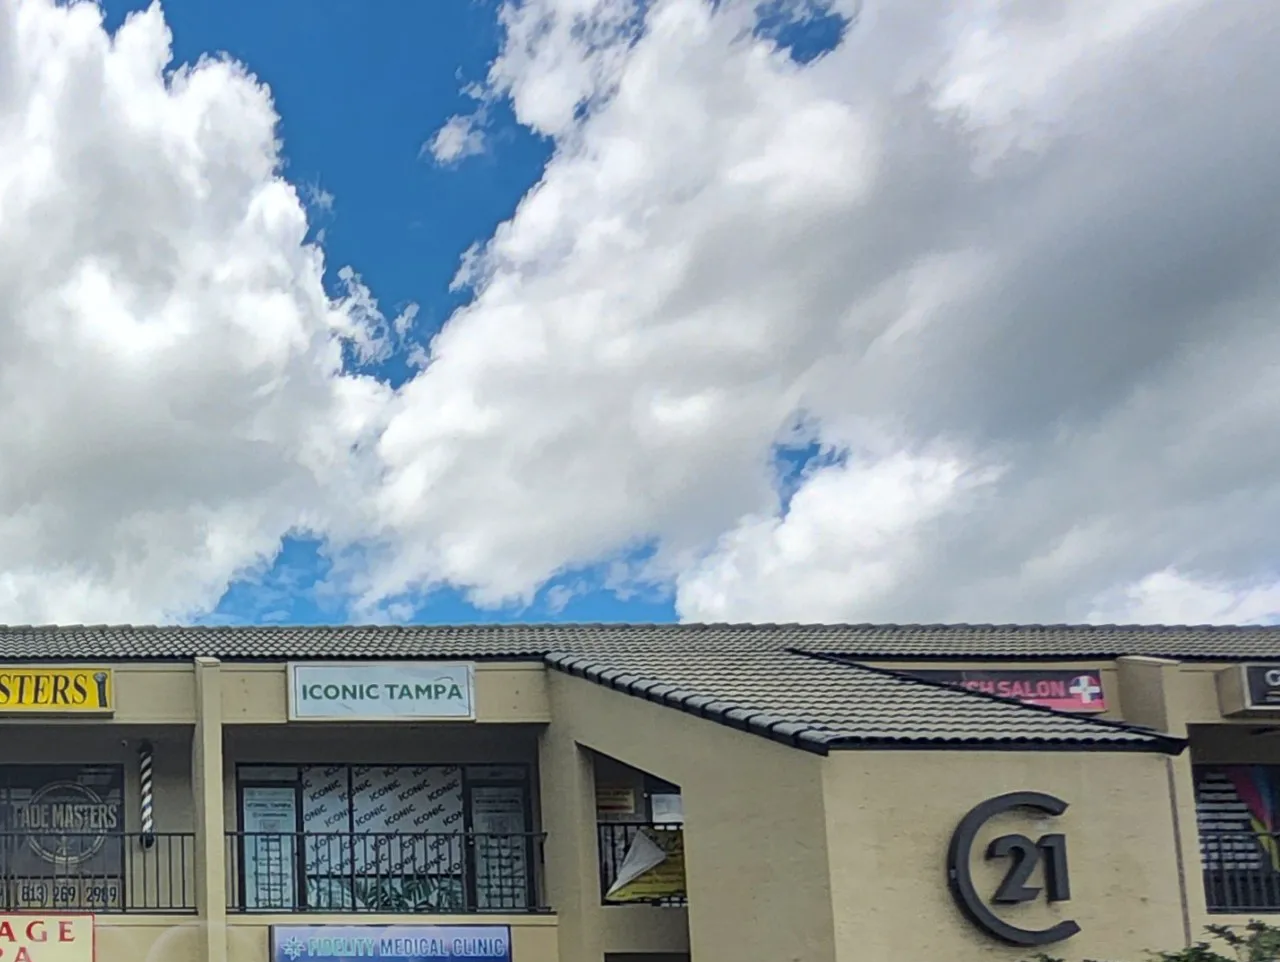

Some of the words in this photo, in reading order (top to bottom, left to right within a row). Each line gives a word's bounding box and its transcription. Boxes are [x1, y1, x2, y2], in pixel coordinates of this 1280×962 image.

[301, 684, 381, 700] ICONIC
[384, 684, 463, 700] TAMPA
[997, 680, 1066, 698] SALON
[309, 780, 342, 801] ICONIC
[368, 780, 401, 801] ICONIC
[398, 779, 430, 801] ICONIC
[427, 779, 459, 801] ICONIC
[324, 806, 358, 827] ICON
[355, 804, 387, 826] ICONIC
[384, 804, 416, 826] ICONIC
[413, 804, 445, 826] ICONIC
[984, 833, 1071, 905] 21
[53, 886, 76, 903] 269
[308, 937, 375, 958] FIDELITY
[379, 937, 450, 957] MEDICAL
[452, 937, 505, 957] CLINIC
